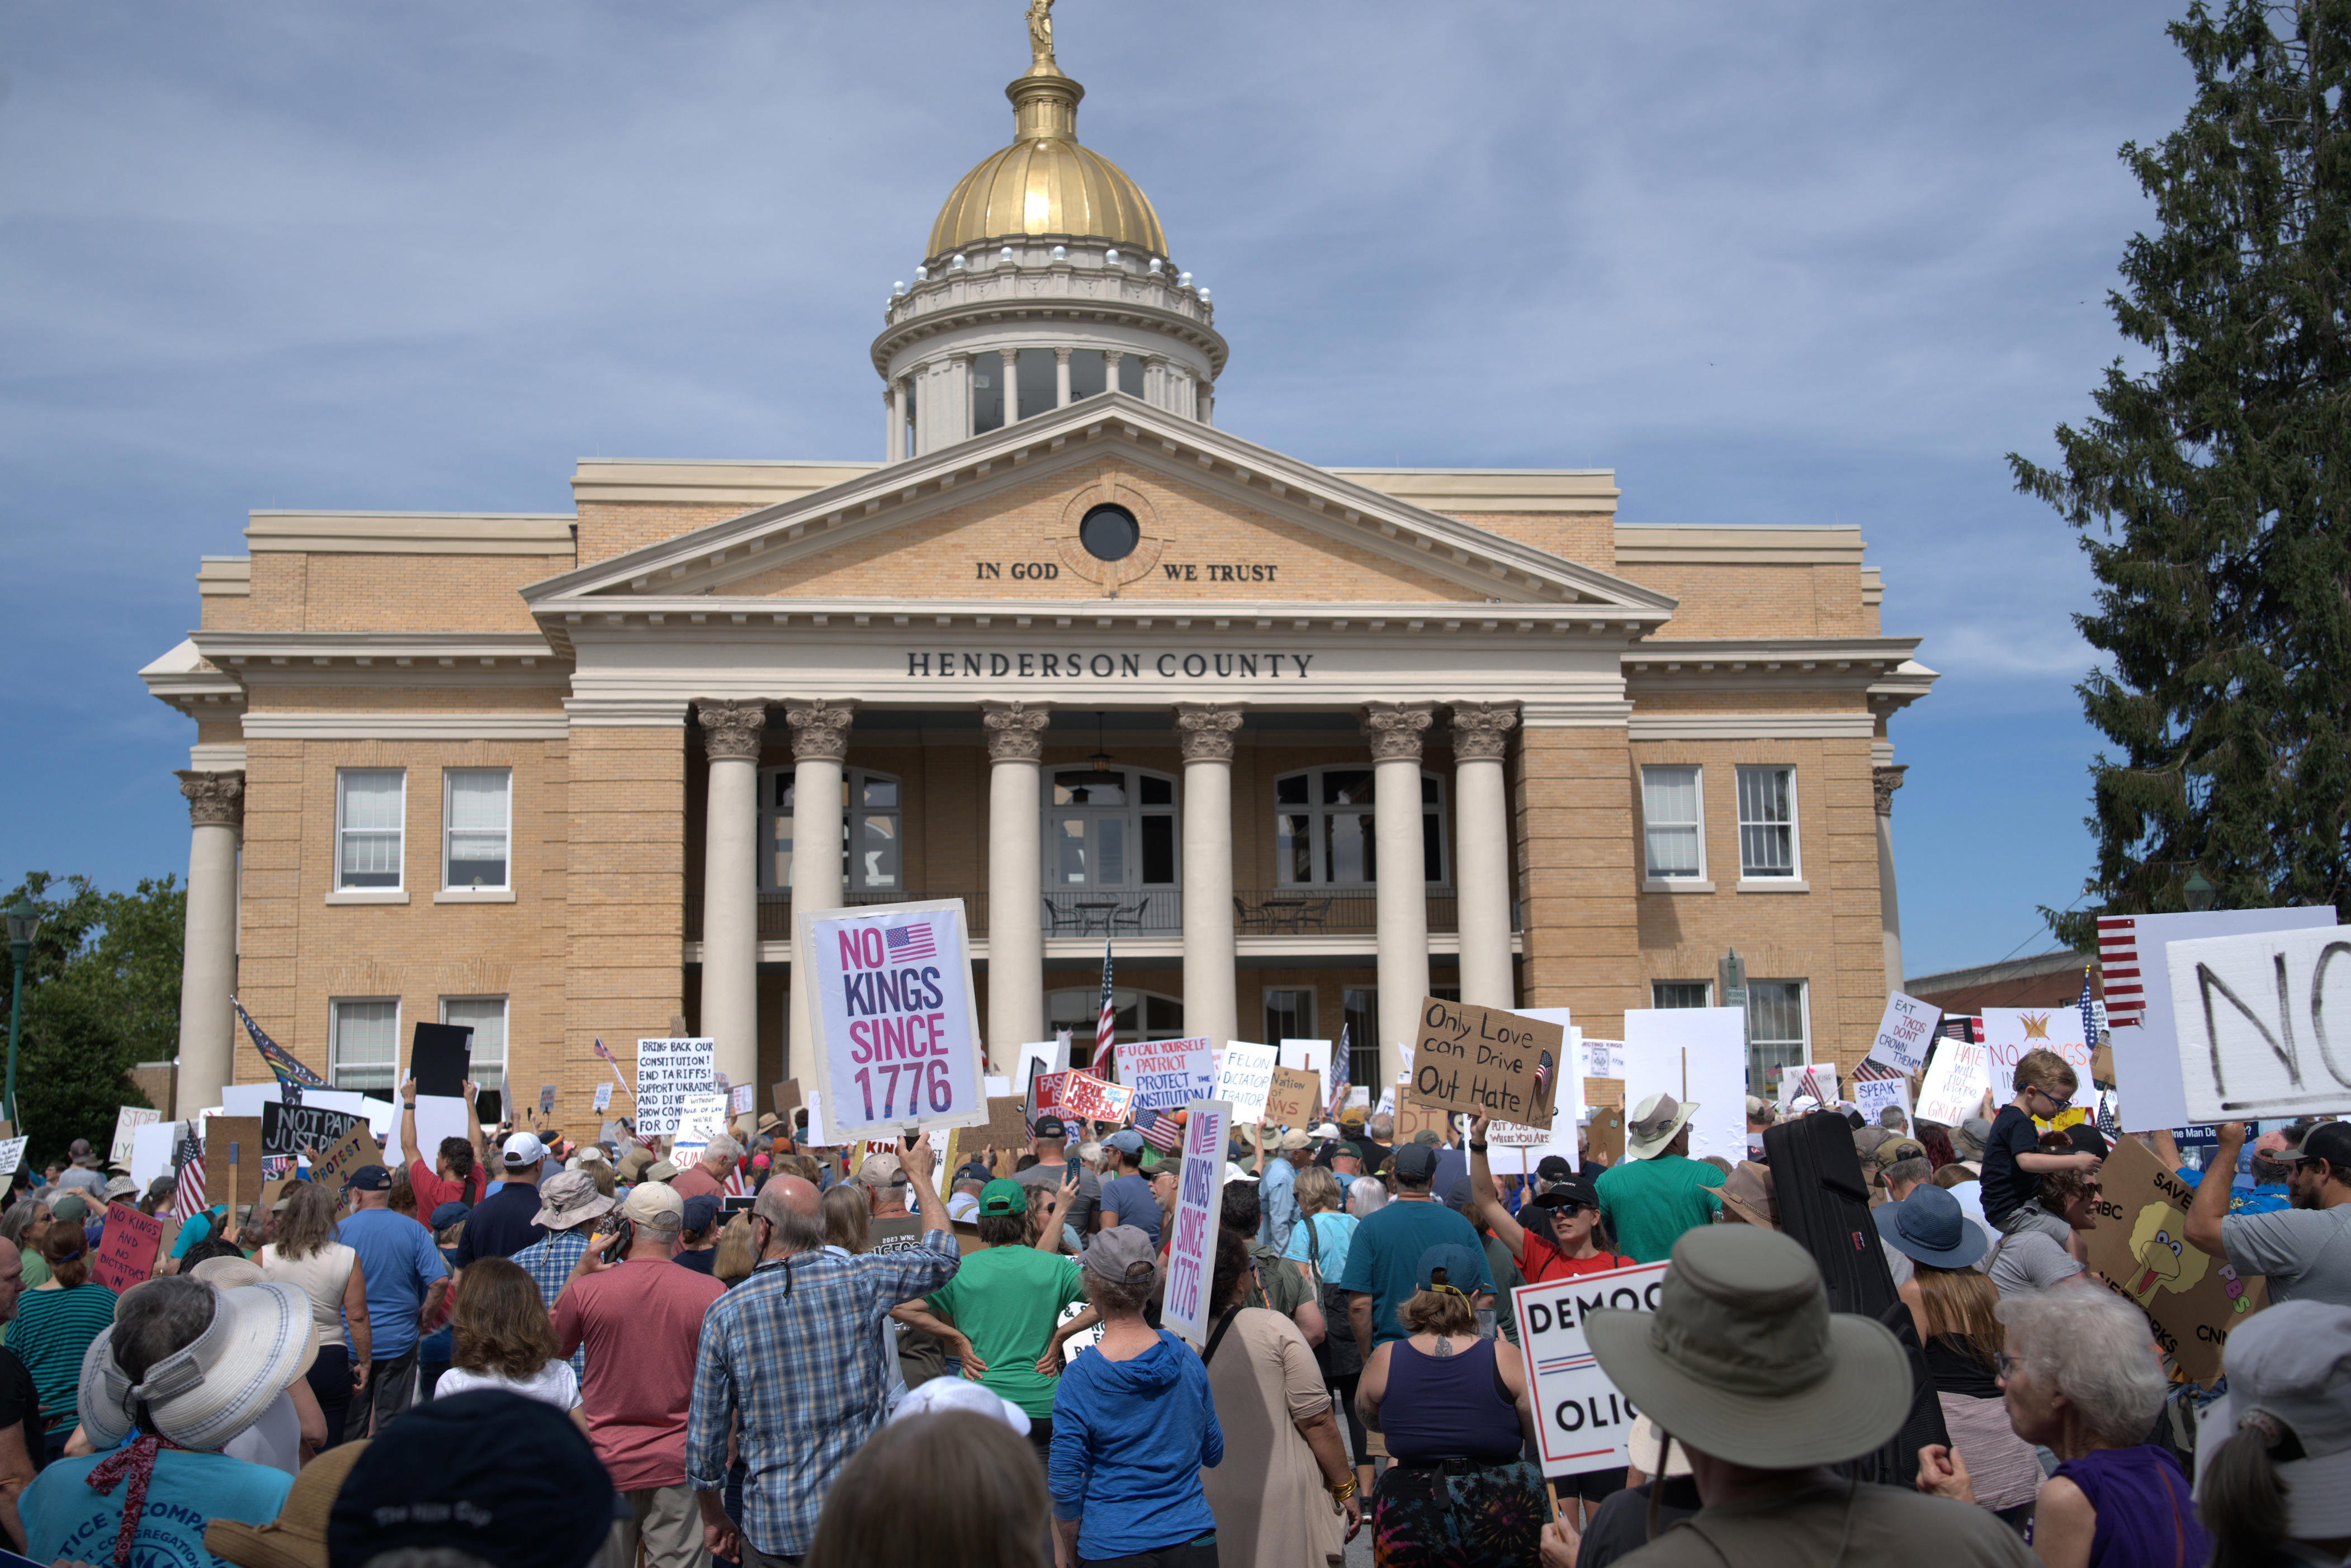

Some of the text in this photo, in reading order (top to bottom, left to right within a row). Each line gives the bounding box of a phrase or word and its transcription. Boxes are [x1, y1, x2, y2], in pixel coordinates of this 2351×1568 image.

[976, 562, 1059, 580] IN GOD
[1163, 564, 1278, 582] WE TRUST
[907, 652, 1314, 678] HENDERSON COUNTY
[838, 927, 884, 971] NO
[844, 966, 944, 1017] KINGS
[1895, 998, 1917, 1016] EAT
[1426, 1003, 1534, 1049] Only Love
[1893, 1025, 1919, 1043] DONT
[1902, 1015, 1927, 1034] TACOS
[642, 1041, 713, 1052] BRING BACK OUR
[849, 1012, 949, 1064] SINCE
[1879, 1034, 1908, 1053] CROWN
[1116, 1038, 1207, 1058] IF U CALL YOURSELF
[1423, 1038, 1523, 1074] can Drive
[1953, 1043, 1985, 1068] HATE
[1989, 1043, 2087, 1067] NO NGS
[640, 1055, 710, 1067] CONSTITUTION!
[1136, 1054, 1187, 1074] PATRIOT
[1228, 1052, 1271, 1069] FELON
[638, 1068, 711, 1081] END TARIFFS!
[1136, 1072, 1212, 1091] PROTECT THE
[1223, 1071, 1270, 1089] DICTATOR
[1270, 1073, 1305, 1090] Nation
[637, 1082, 714, 1094] SUPPORT UKRAINE
[854, 1059, 952, 1121] 1776
[1069, 1074, 1106, 1100] PUBLIC
[1271, 1088, 1284, 1097] of
[1418, 1065, 1521, 1112] Out Hate
[1858, 1082, 1896, 1098] SPEAK
[637, 1095, 658, 1106] AND
[1073, 1089, 1115, 1111] HEALTH
[1221, 1089, 1265, 1107] TRAITOR
[1266, 1097, 1300, 1115] AWS
[278, 1106, 323, 1134] NOT
[638, 1107, 683, 1118] SHOW COM
[640, 1119, 661, 1133] FOR
[1398, 1110, 1438, 1135] DT
[1491, 1121, 1508, 1131] PUT
[266, 1128, 318, 1154] JUST
[1189, 1111, 1205, 1156] NO
[1489, 1132, 1550, 1143] WHERE YOU ARE
[2185, 1128, 2204, 1138] Man
[312, 1138, 362, 1182] PROTEST
[674, 1150, 703, 1170] SUN
[1182, 1157, 1213, 1209] KINGS
[2153, 1172, 2193, 1210] SAVE
[110, 1206, 159, 1236] NO KINGS
[117, 1230, 139, 1248] AND
[882, 1235, 898, 1244] 2023
[1176, 1206, 1207, 1259] SINCE
[115, 1248, 129, 1260] NO
[100, 1253, 146, 1281] DICTATORS
[110, 1274, 125, 1288] IN
[1169, 1254, 1200, 1321] 1776
[2217, 1263, 2251, 1314] PBS
[57, 1512, 109, 1558] TICE
